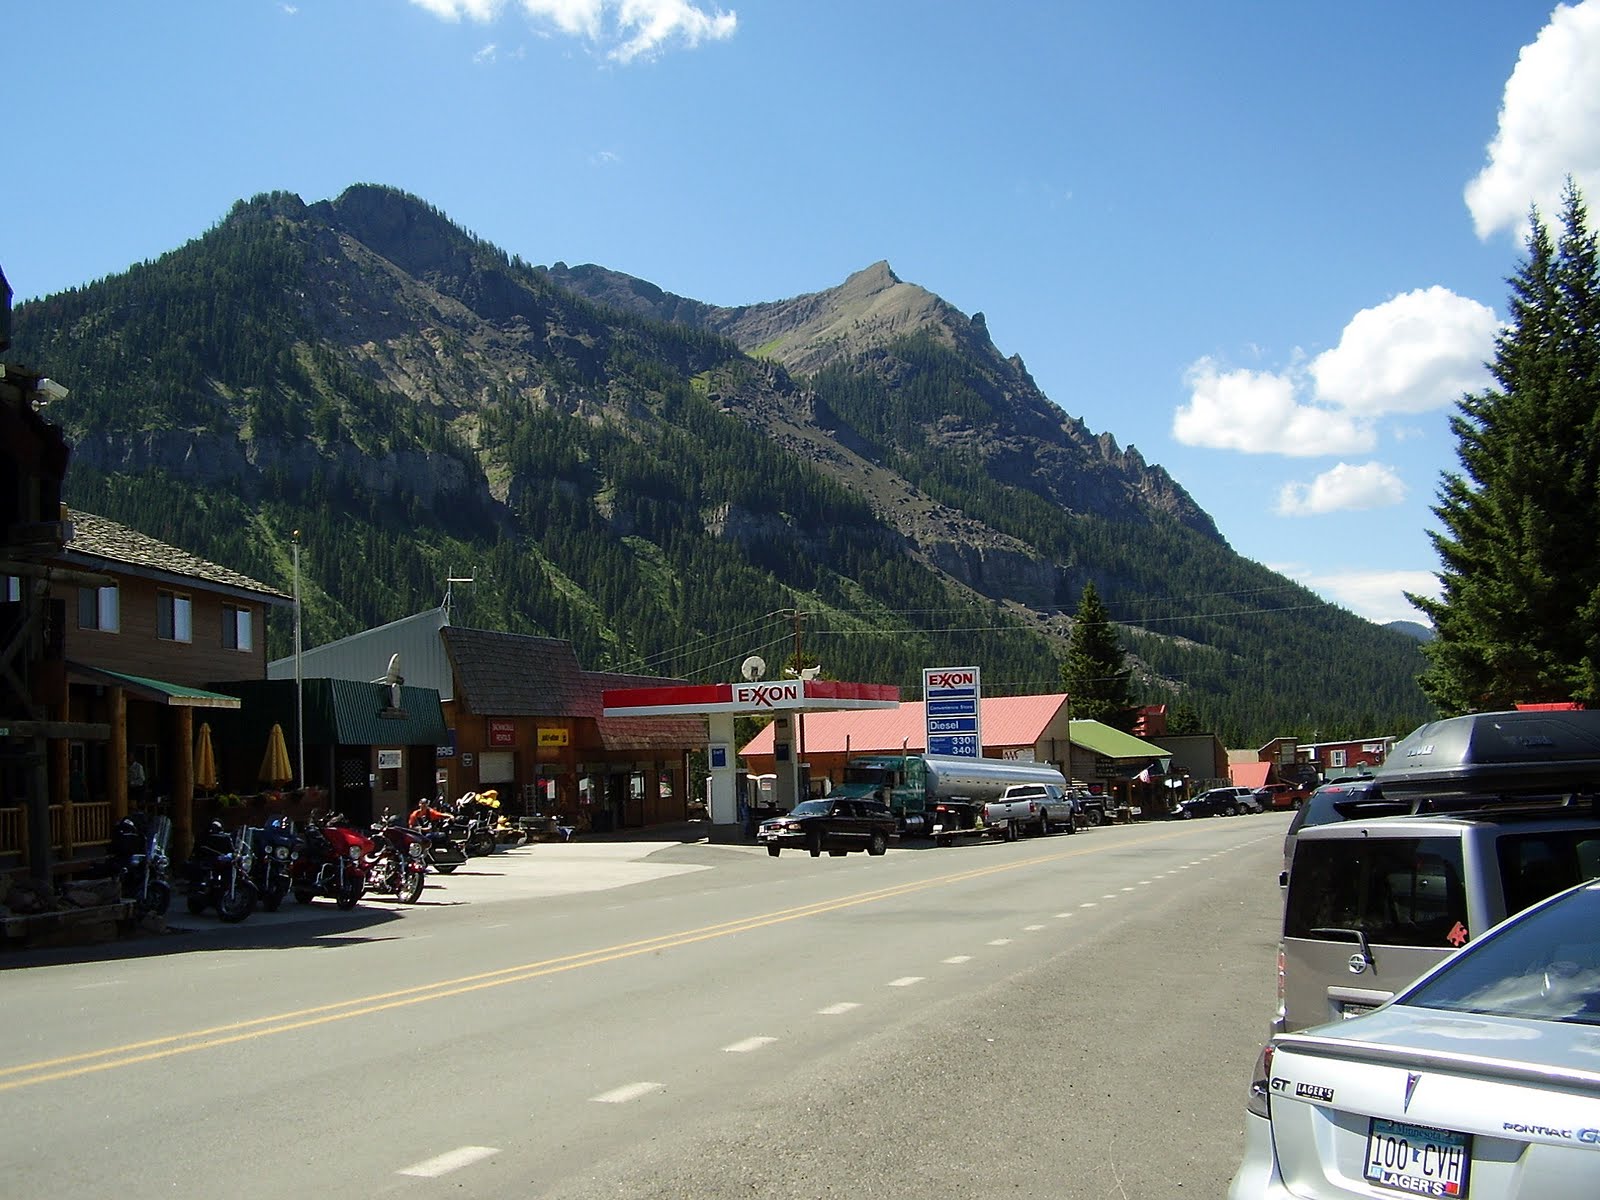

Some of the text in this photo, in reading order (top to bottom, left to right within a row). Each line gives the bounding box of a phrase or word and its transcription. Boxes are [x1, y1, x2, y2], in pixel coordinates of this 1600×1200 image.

[929, 673, 973, 689] EXXON
[738, 685, 797, 707] EXXON
[930, 720, 959, 730] Diesel
[1271, 1077, 1291, 1092] GT
[1297, 1084, 1333, 1098] LAGER'S
[1503, 1122, 1573, 1139] PONTIAC
[1372, 1134, 1460, 1182] 100 CVH
[1380, 1171, 1445, 1196] LAGER'S
